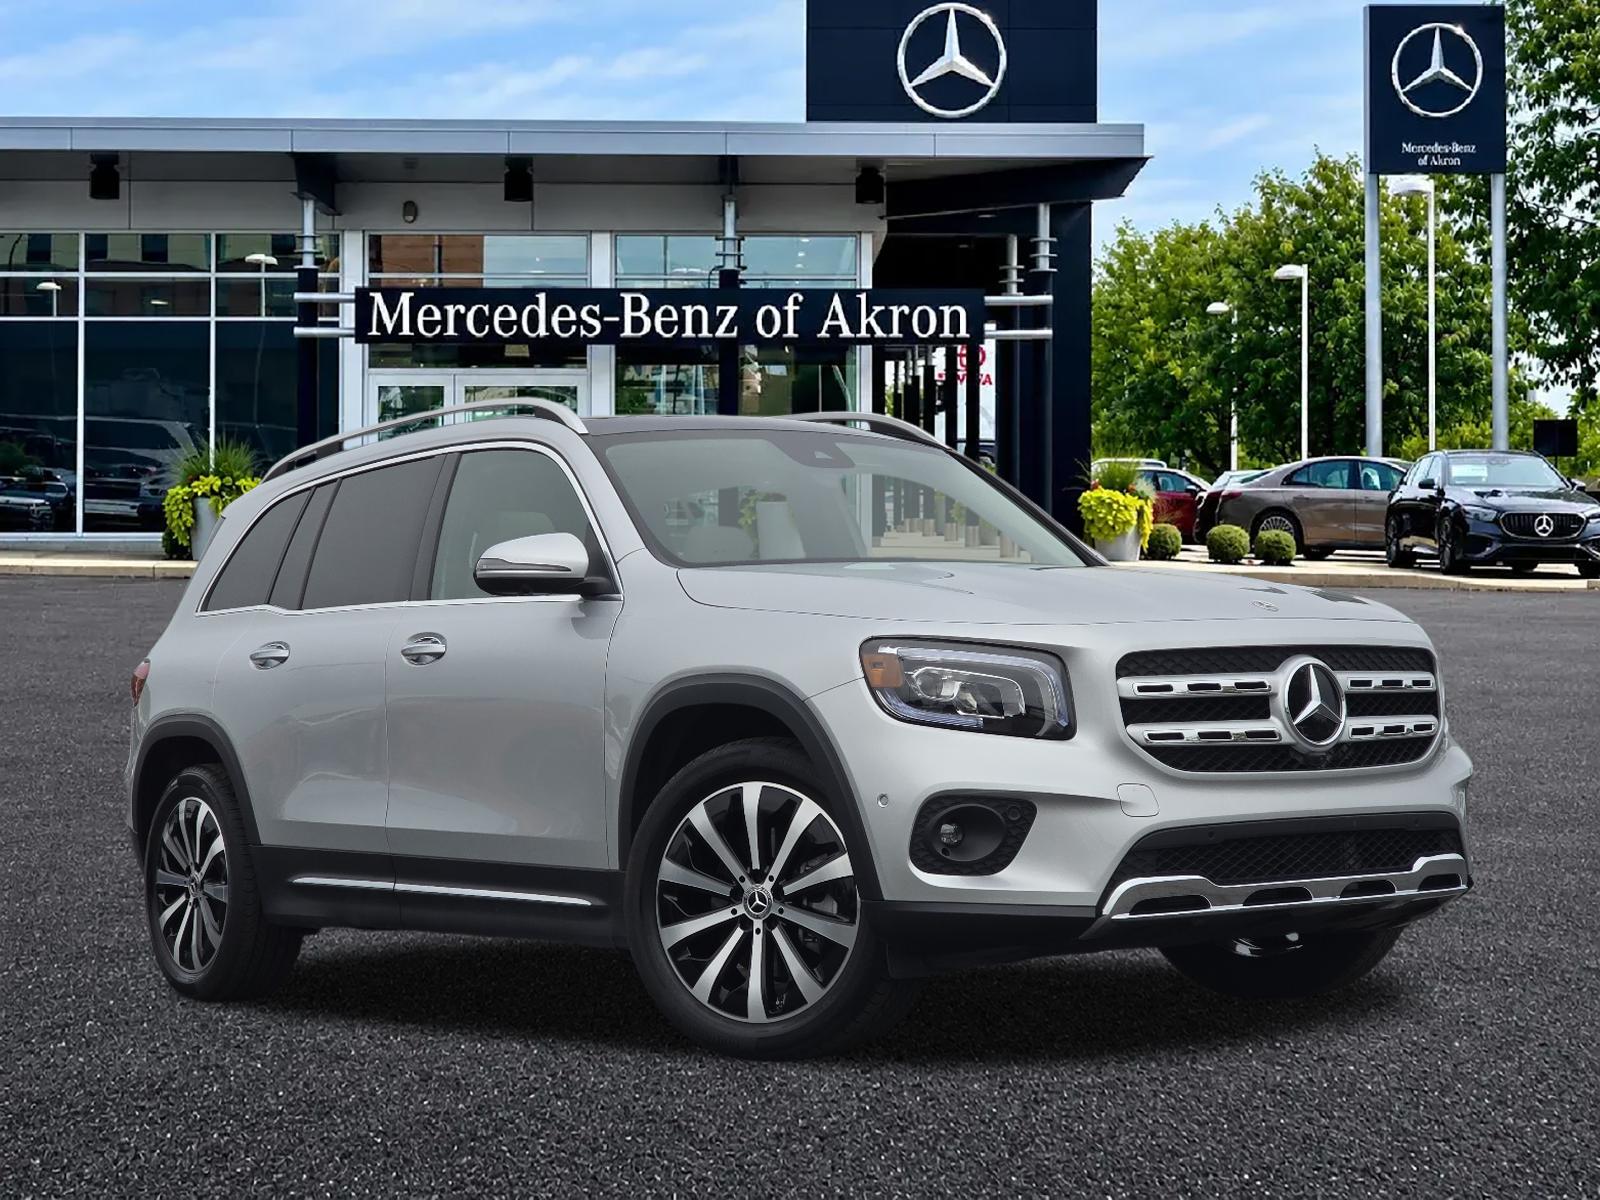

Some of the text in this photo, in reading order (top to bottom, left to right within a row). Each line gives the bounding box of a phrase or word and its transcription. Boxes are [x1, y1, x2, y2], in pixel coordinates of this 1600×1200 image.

[1401, 141, 1477, 154] Mercedes-Benz
[1417, 154, 1461, 166] of Akron
[367, 291, 971, 340] Mercedes-Benz of Akron
